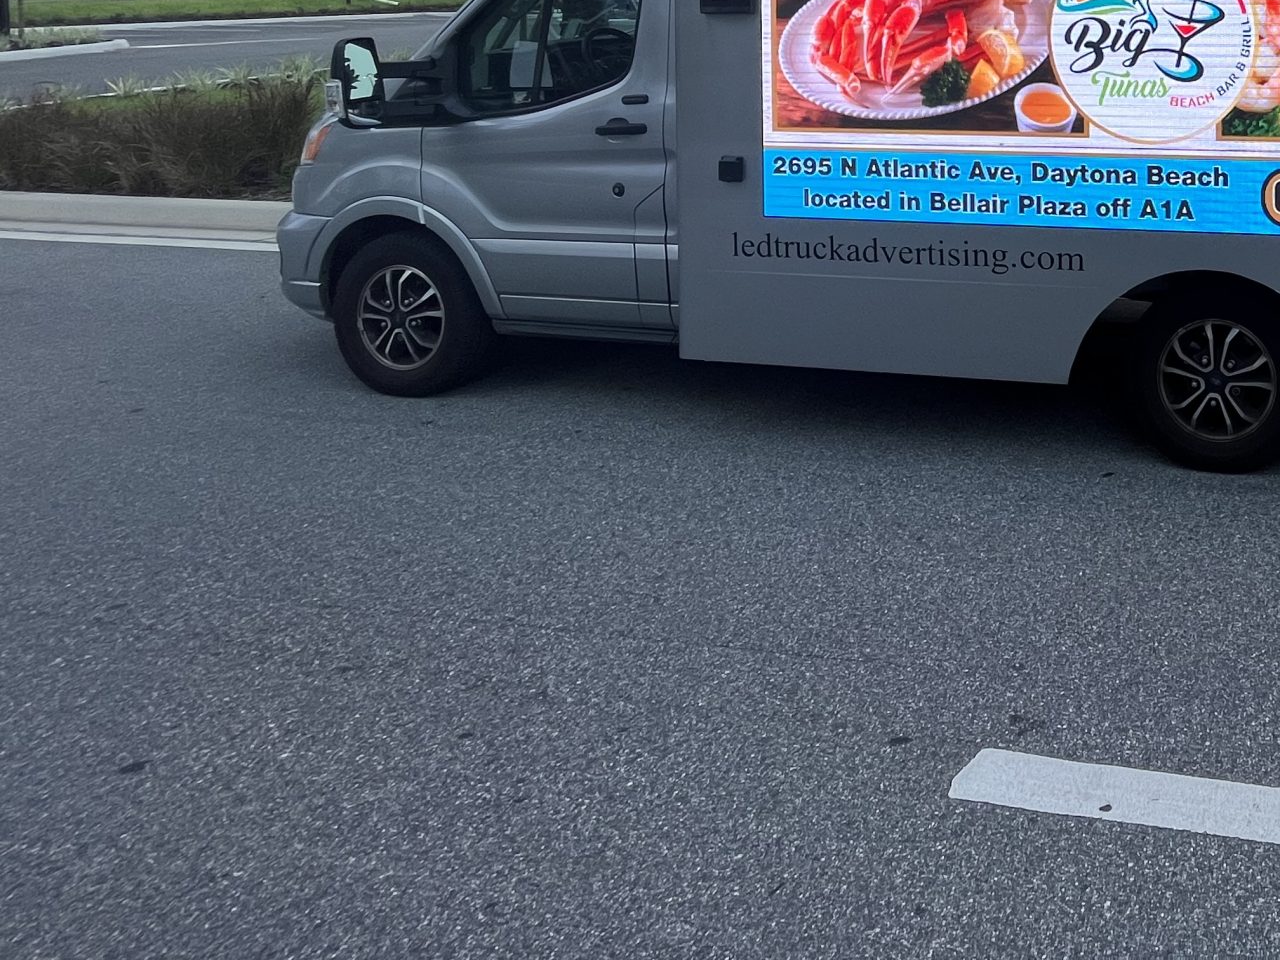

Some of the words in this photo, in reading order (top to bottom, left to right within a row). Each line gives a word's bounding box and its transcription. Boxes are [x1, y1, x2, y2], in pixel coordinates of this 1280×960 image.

[1064, 17, 1152, 74] Big
[1169, 92, 1216, 108] BEACH
[1215, 73, 1241, 97] BAR
[1240, 14, 1253, 59] GRILL
[1091, 70, 1170, 106] Tunas
[772, 156, 832, 176] 2695
[841, 157, 858, 177] N
[866, 157, 962, 181] Atlantic
[968, 161, 1022, 184] Ave,
[1031, 163, 1136, 188] Daytona
[1147, 165, 1230, 188] Beach
[803, 188, 891, 211] located
[900, 191, 921, 212] in
[930, 192, 1010, 215] Bellair
[1018, 196, 1088, 218] Plaza
[1096, 197, 1131, 219] off
[1139, 200, 1196, 221] A1A
[731, 232, 1086, 274] ledtruckadvertising.com
